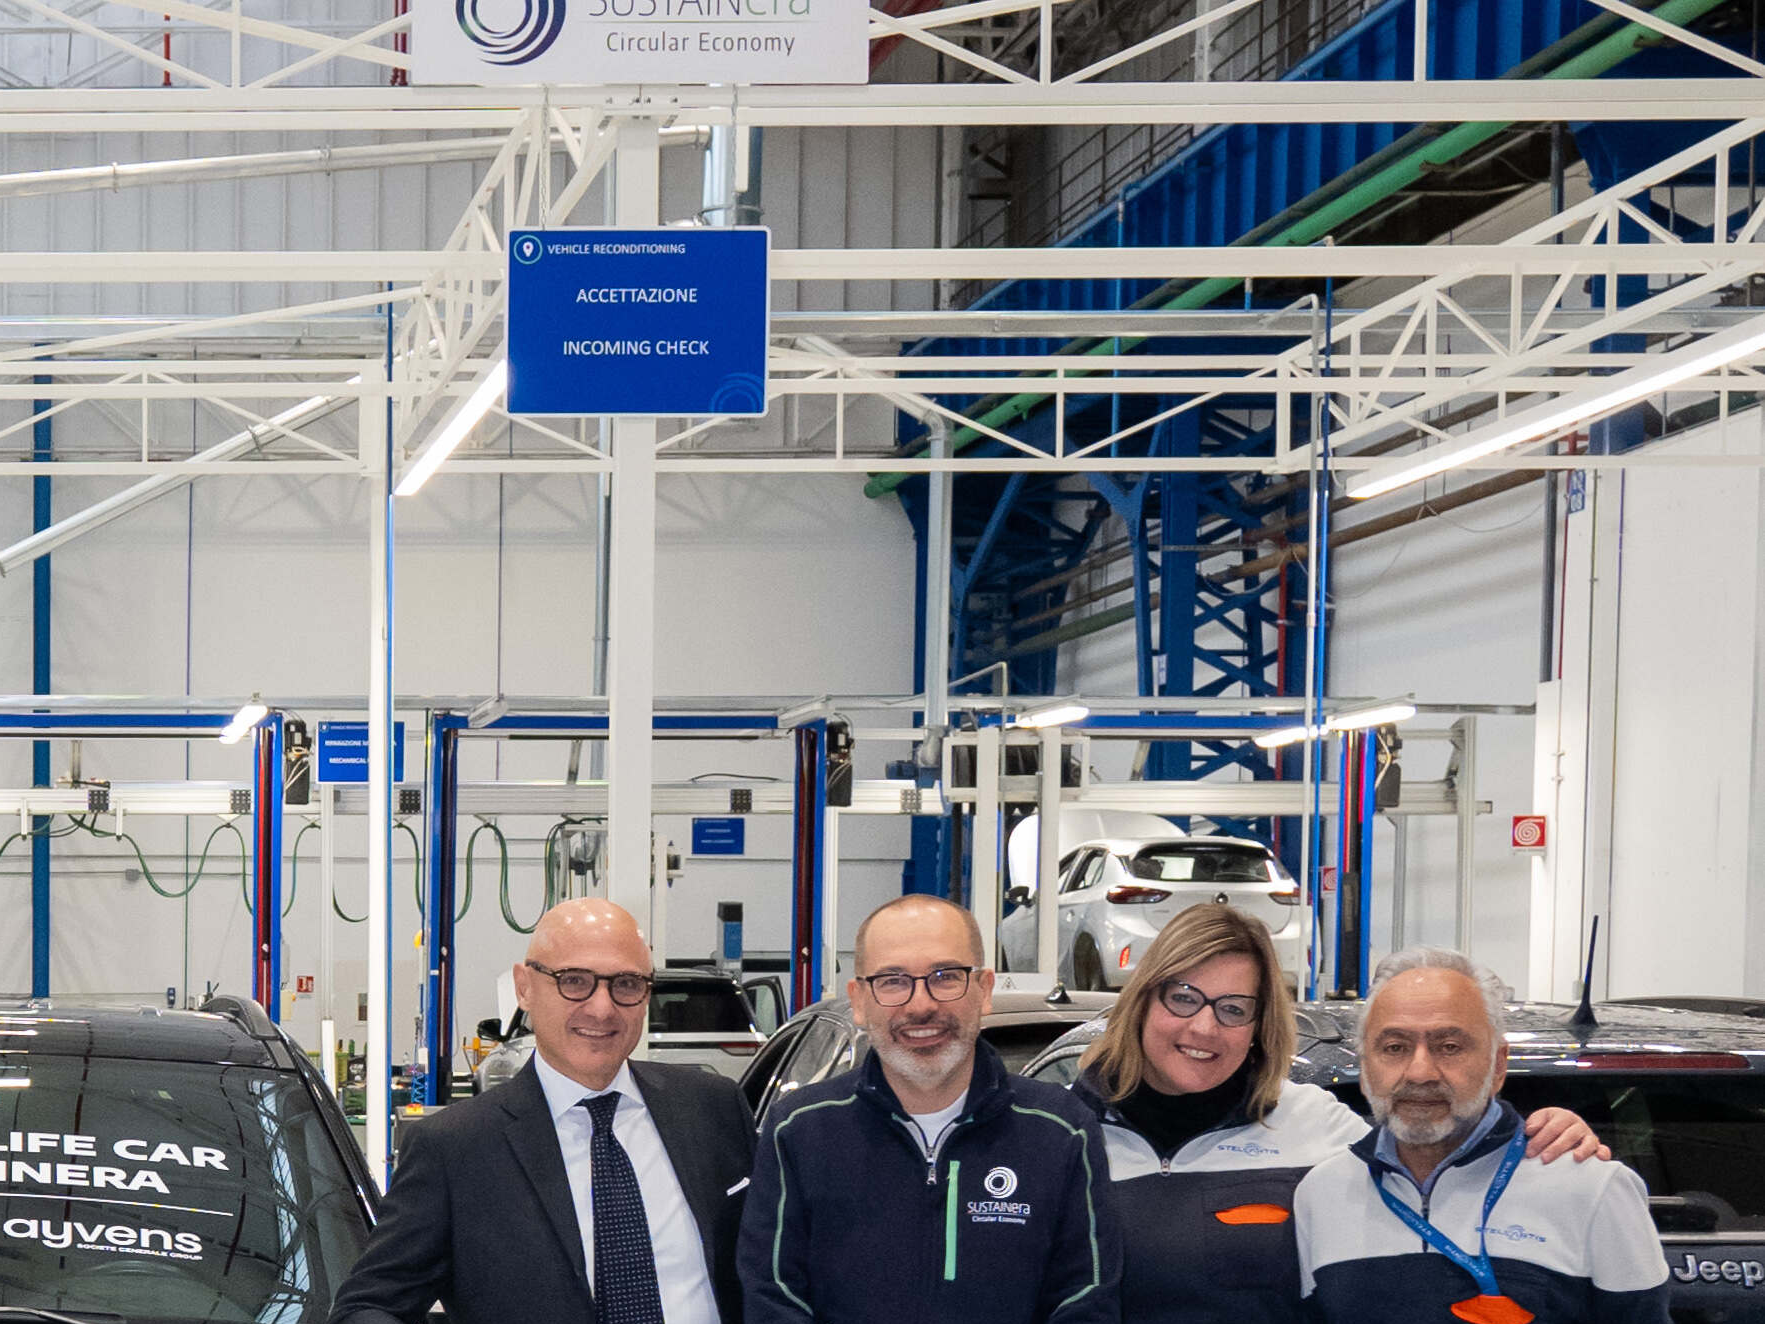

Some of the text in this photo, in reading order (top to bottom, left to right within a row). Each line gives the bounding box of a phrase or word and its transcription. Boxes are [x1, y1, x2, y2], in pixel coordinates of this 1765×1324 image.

[606, 31, 796, 57] Circular Economy
[547, 243, 686, 255] VEHICLE RECONDITIONING
[575, 288, 698, 304] ACCETTAZIONE
[563, 340, 710, 356] INCOMING CHECK
[112, 1139, 230, 1171] CAR
[967, 1201, 1031, 1215] SUSTAINera
[3, 1218, 203, 1254] ayvens
[1673, 1254, 1765, 1287] Jeep
